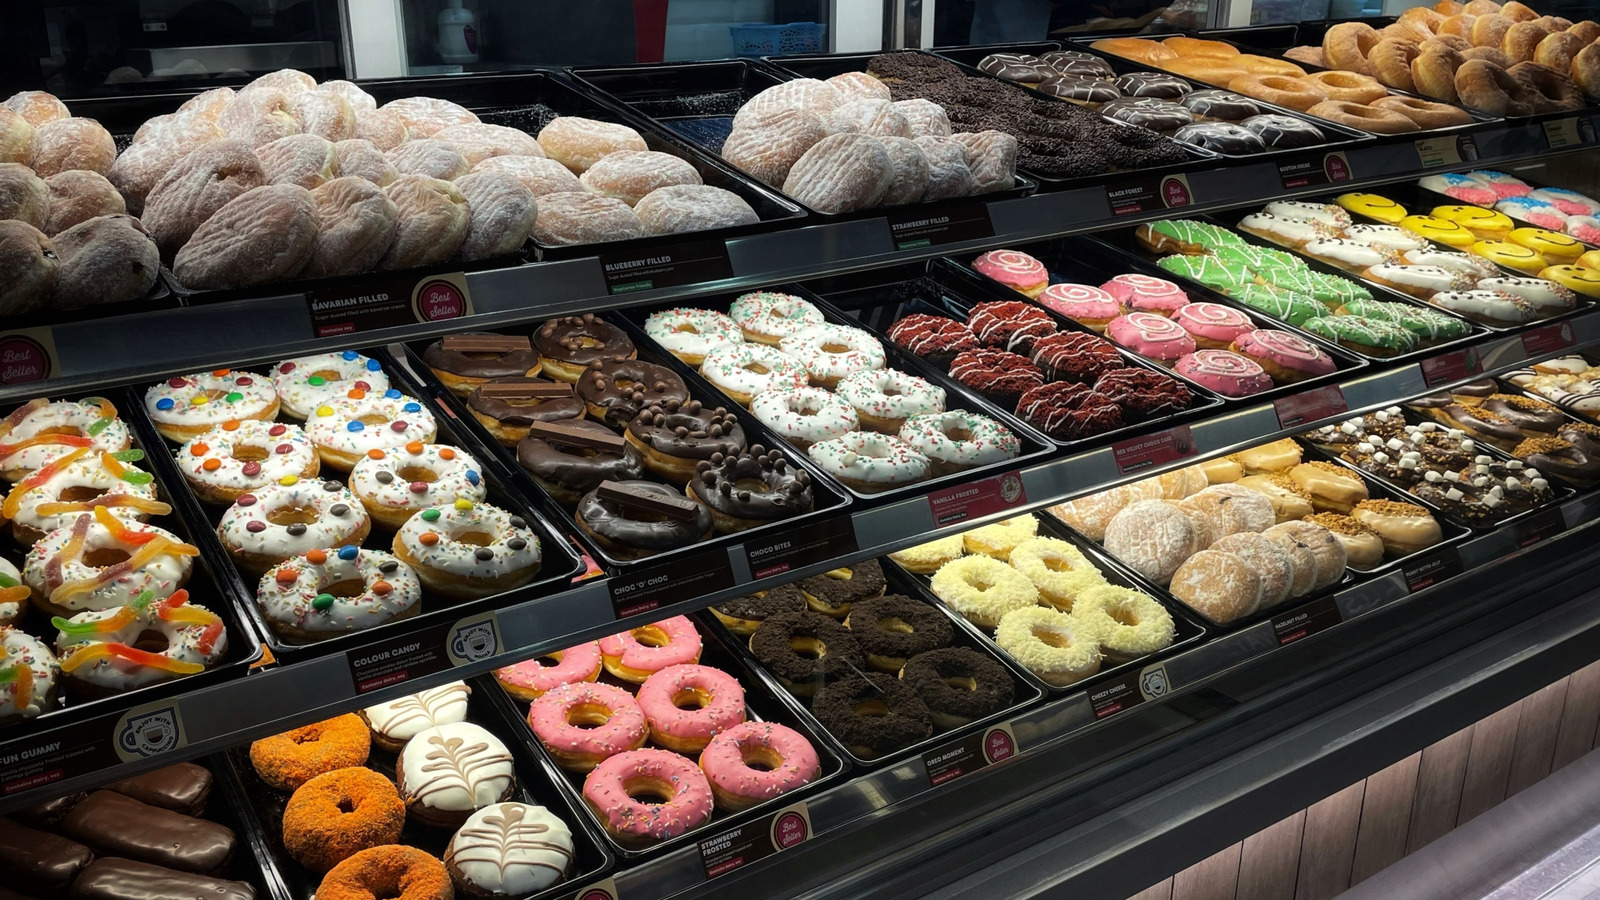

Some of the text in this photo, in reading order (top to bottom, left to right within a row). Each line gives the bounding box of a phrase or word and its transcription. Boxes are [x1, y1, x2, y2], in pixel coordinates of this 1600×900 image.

[1108, 187, 1144, 198] BLACK FOREST
[1169, 186, 1181, 195] Best
[892, 216, 950, 231] STRAWBERRY FILLED
[605, 256, 672, 272] BLUEBERRY FILLED
[312, 293, 390, 311] BAVARIAN FILLED
[429, 292, 452, 304] Best
[430, 304, 458, 318] Seller
[2, 348, 32, 364] Best
[2, 365, 38, 382] Seller
[932, 494, 956, 505] VANILLA
[956, 488, 980, 500] FROSTED
[750, 546, 774, 558] CHOCO
[774, 541, 792, 551] BITES
[614, 574, 668, 595] CHOC 'O' CHOC
[463, 627, 491, 642] ENJOY WITH
[354, 642, 421, 668] COLOUR CANDY
[362, 680, 383, 690] Contains
[136, 716, 172, 734] ENJOY WITH
[20, 742, 61, 760] GUMMY
[142, 736, 174, 753] CAPPUCCINO
[992, 738, 1004, 748] Best
[926, 756, 942, 766] OREO
[942, 746, 966, 760] MOMENT
[992, 747, 1009, 760] Seller
[5, 780, 32, 792] Contains
[782, 820, 798, 832] Best
[700, 828, 742, 850] STRAWBERRY
[782, 831, 802, 846] Seller
[702, 840, 732, 856] FROSTED
